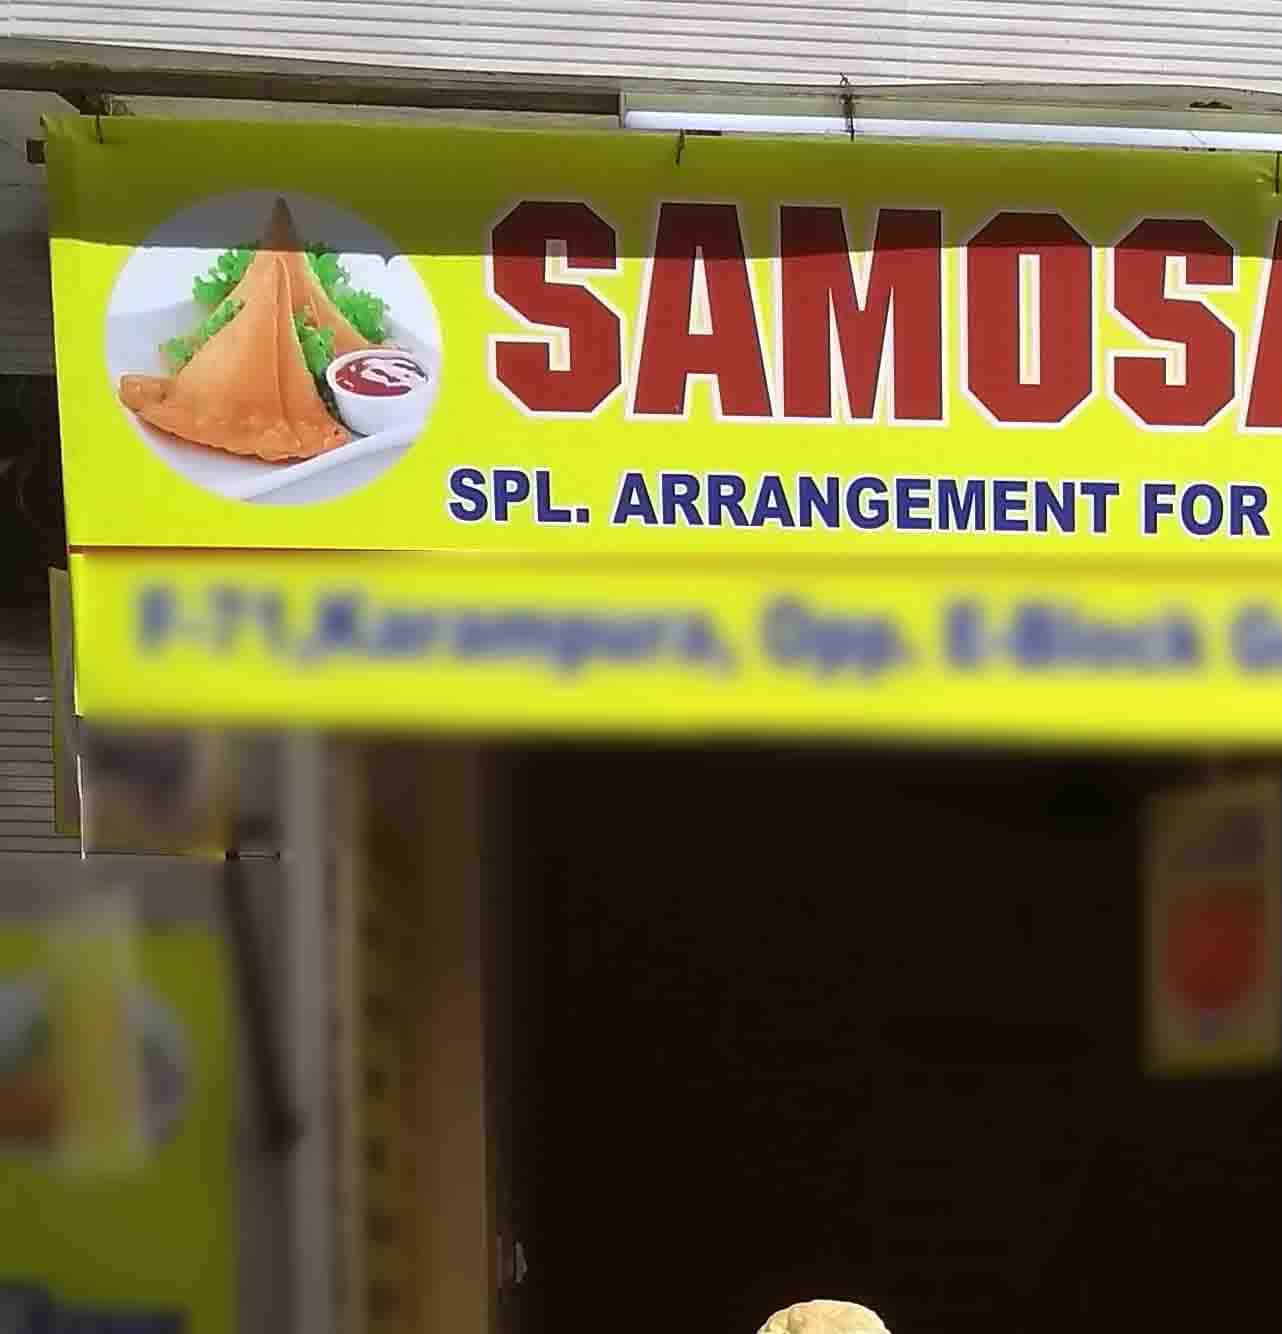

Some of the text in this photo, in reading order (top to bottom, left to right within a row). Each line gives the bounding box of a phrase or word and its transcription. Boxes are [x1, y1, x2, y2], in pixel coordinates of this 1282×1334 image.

[449, 469, 587, 524] SPL.
[613, 473, 1118, 533] ARRANGEMENT
[1143, 484, 1267, 537] FOR
